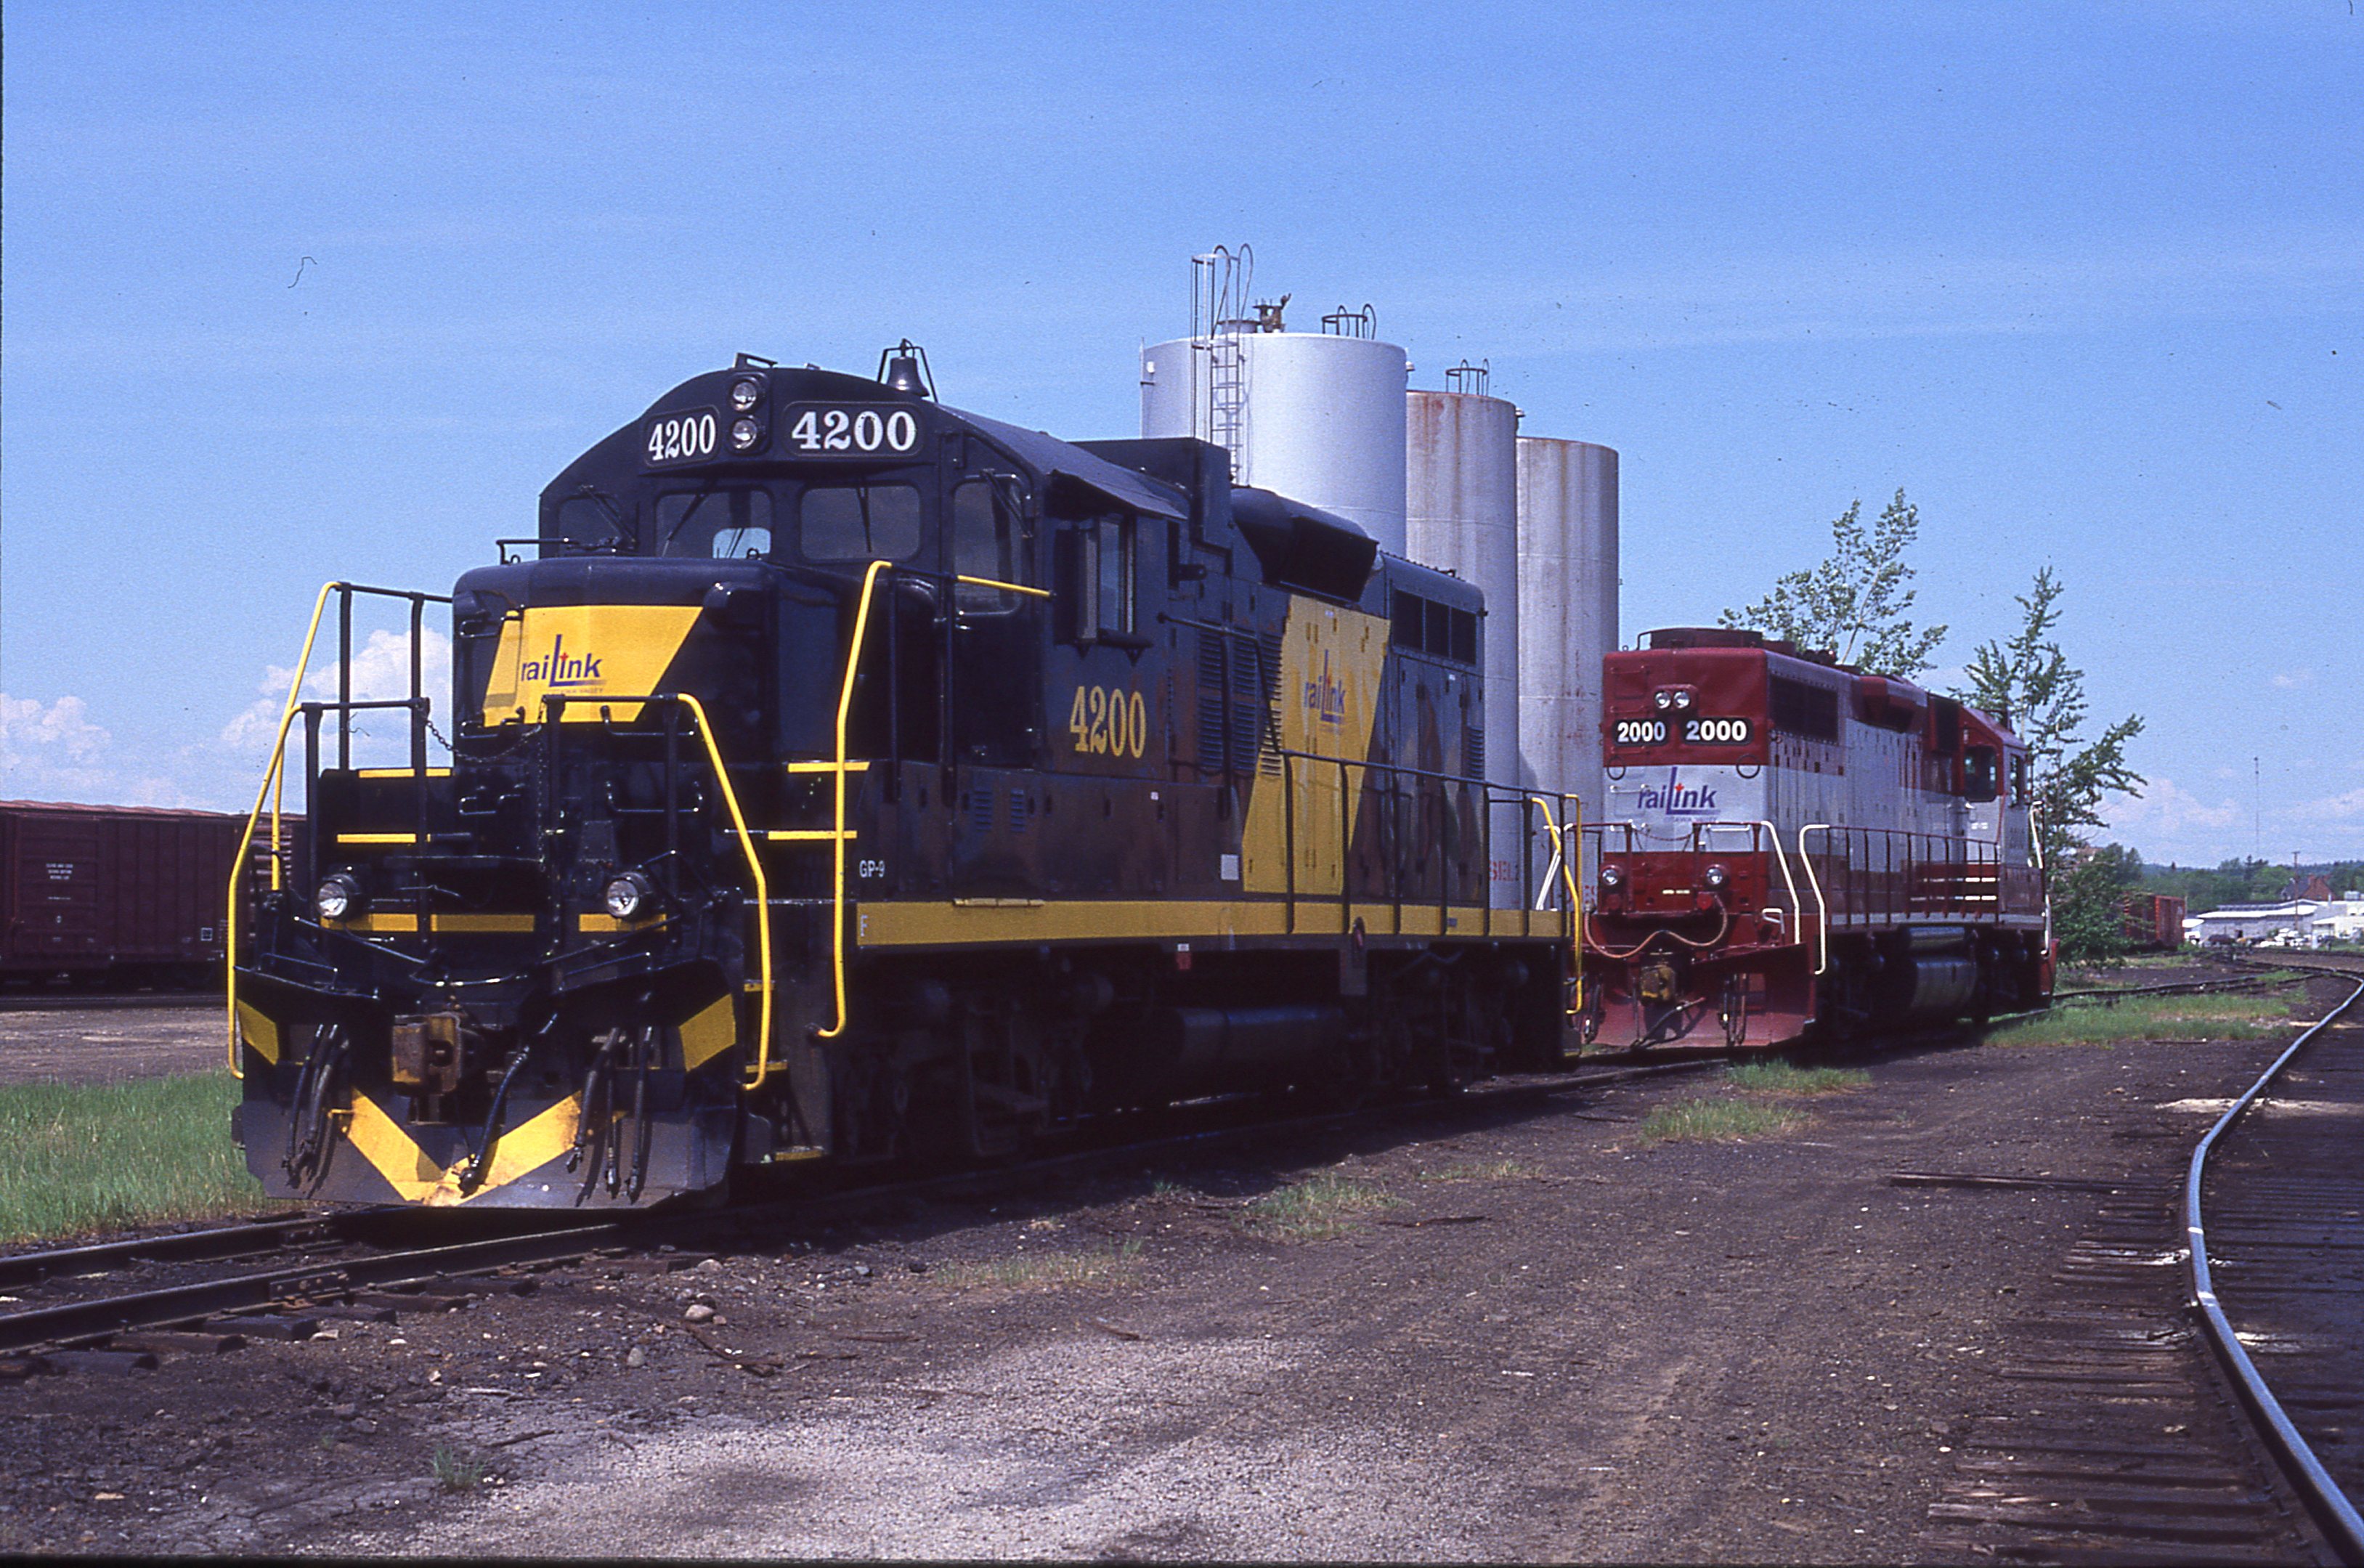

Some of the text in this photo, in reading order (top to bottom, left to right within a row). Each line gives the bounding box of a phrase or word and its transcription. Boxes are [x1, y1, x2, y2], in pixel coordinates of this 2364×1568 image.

[648, 413, 717, 461] 4200
[792, 410, 917, 452] 4200
[1070, 686, 1146, 758] 4200
[1617, 721, 1667, 743] 2000
[1686, 720, 1747, 742] 2000
[859, 860, 885, 878] GP-9
